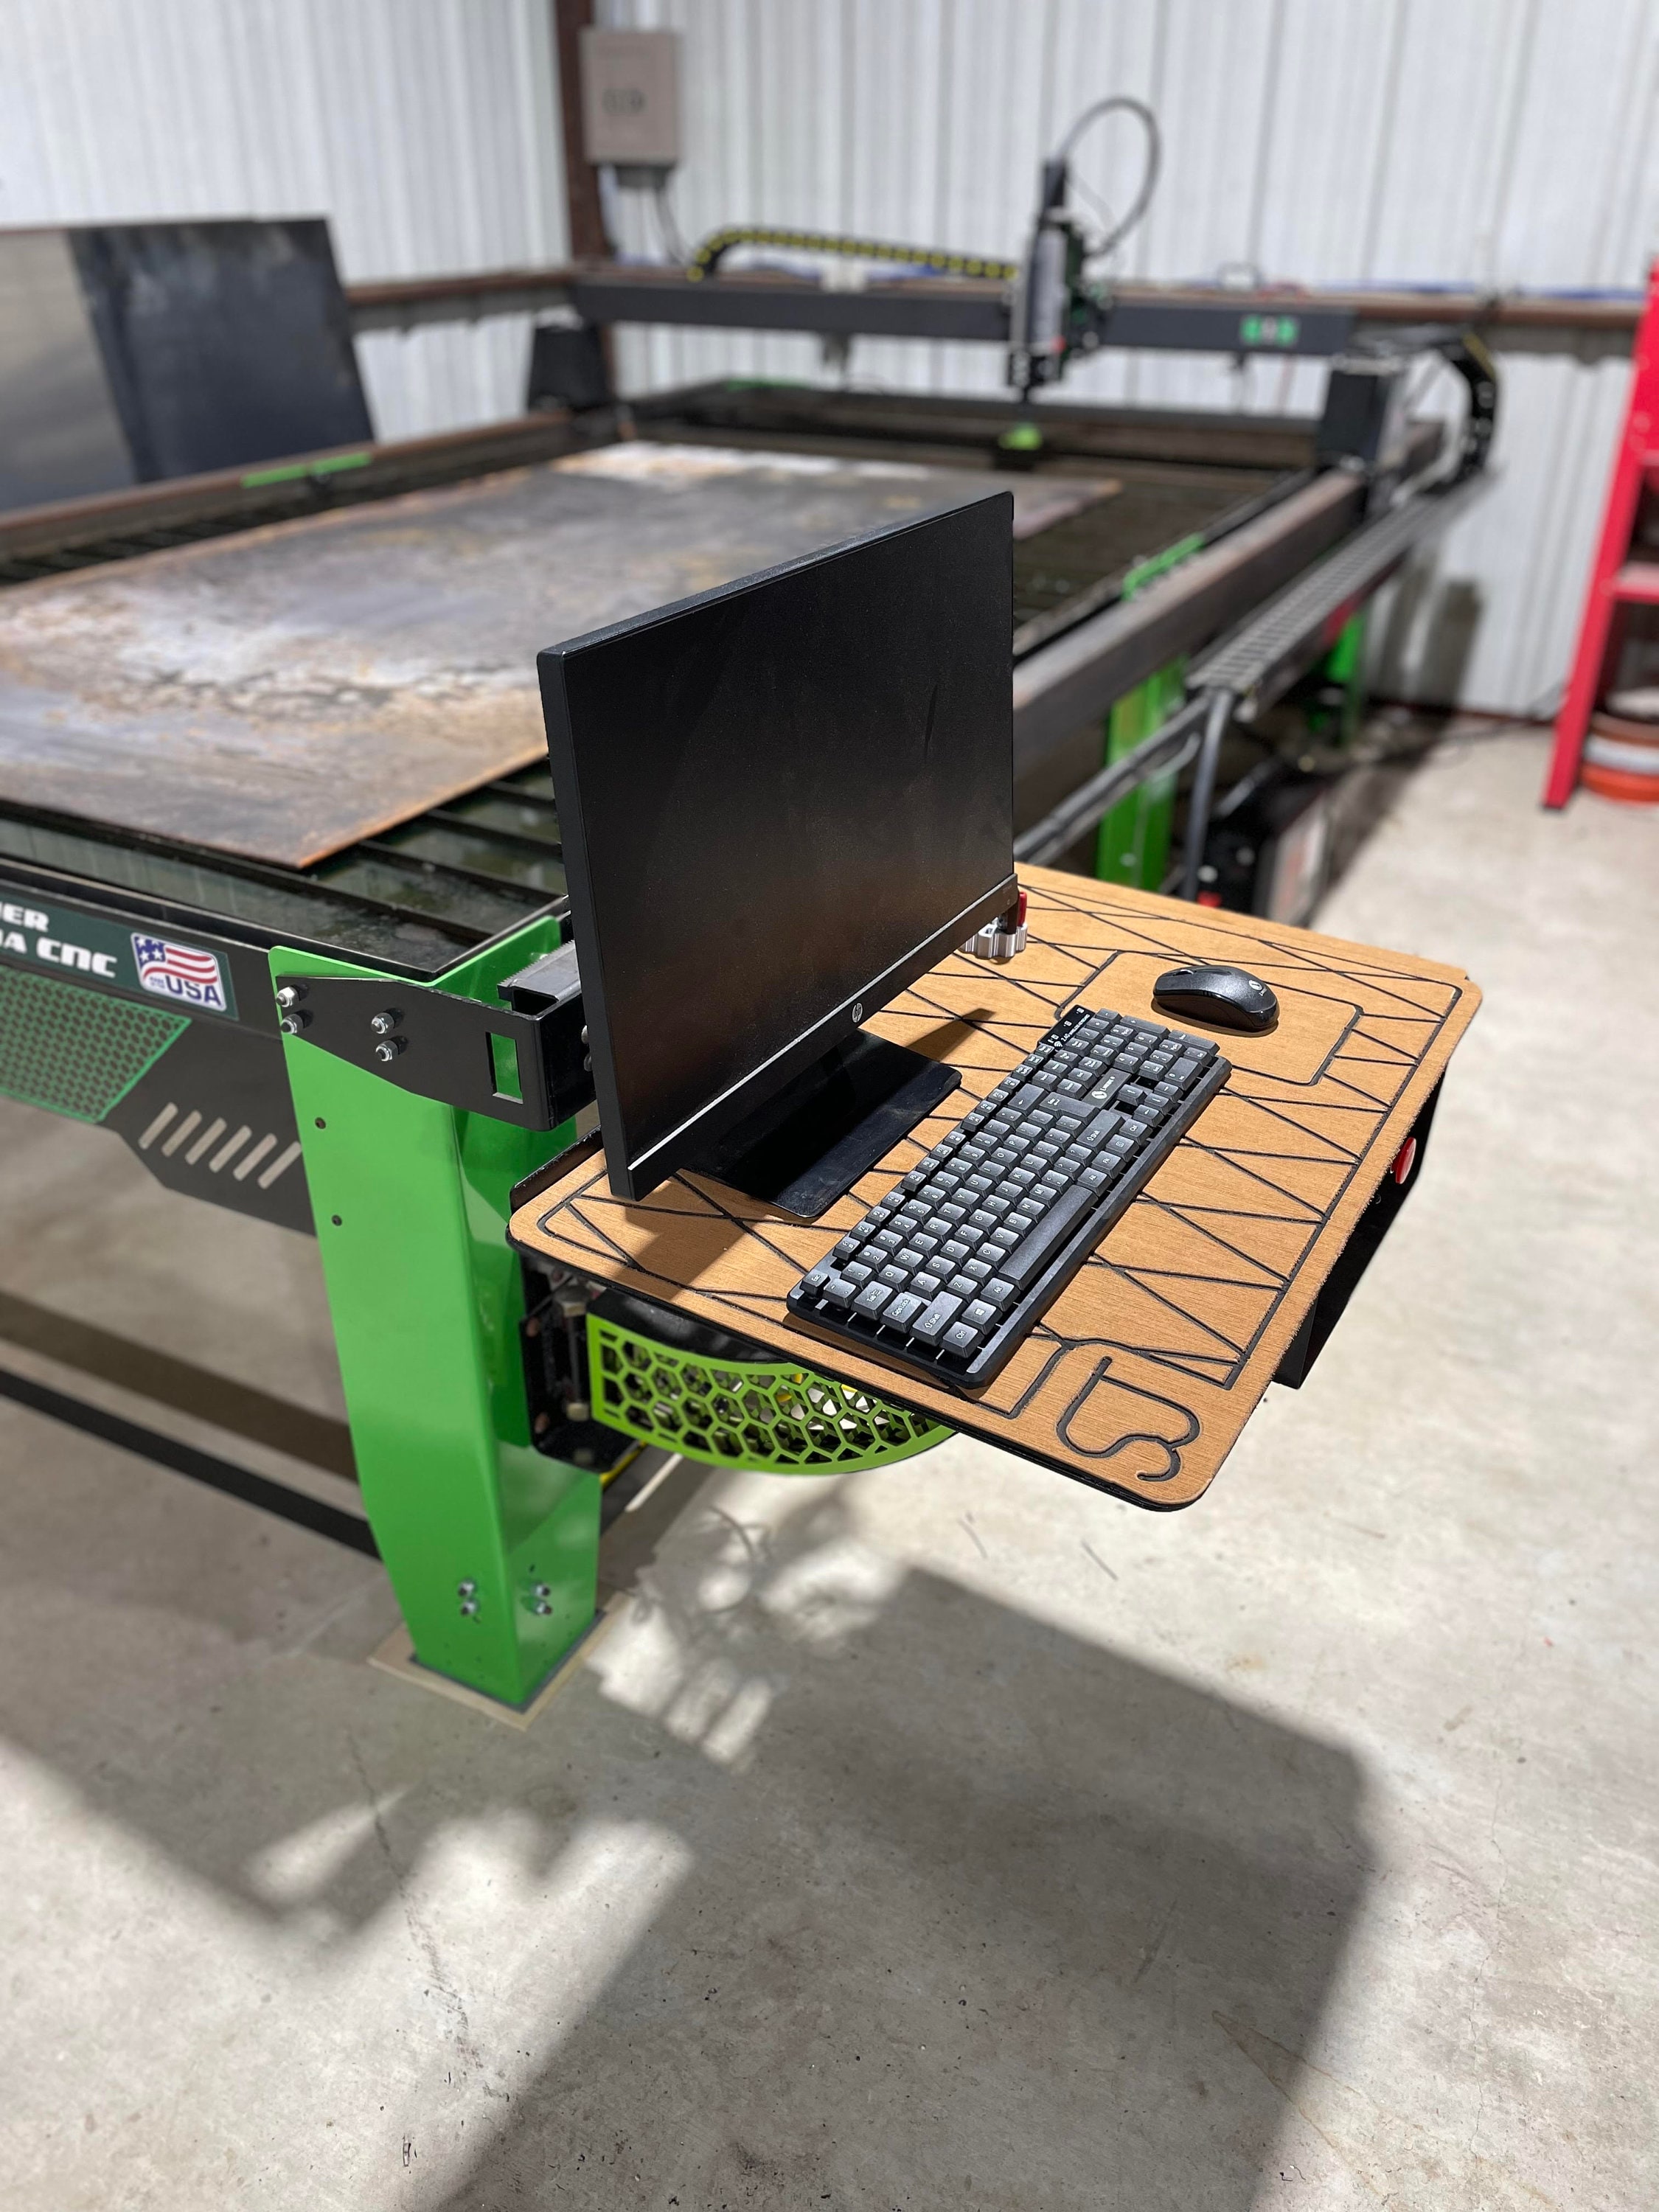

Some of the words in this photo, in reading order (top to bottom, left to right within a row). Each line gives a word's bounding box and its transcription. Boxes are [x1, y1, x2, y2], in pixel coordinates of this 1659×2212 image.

[0, 901, 49, 933] ER
[0, 928, 27, 954] A
[165, 975, 222, 1006] USA
[866, 1293, 877, 1301] Tab
[892, 1306, 902, 1315] Caps
[901, 1298, 911, 1307] Lock
[929, 1314, 941, 1324] Shift
[956, 1329, 966, 1338] Ctrl
